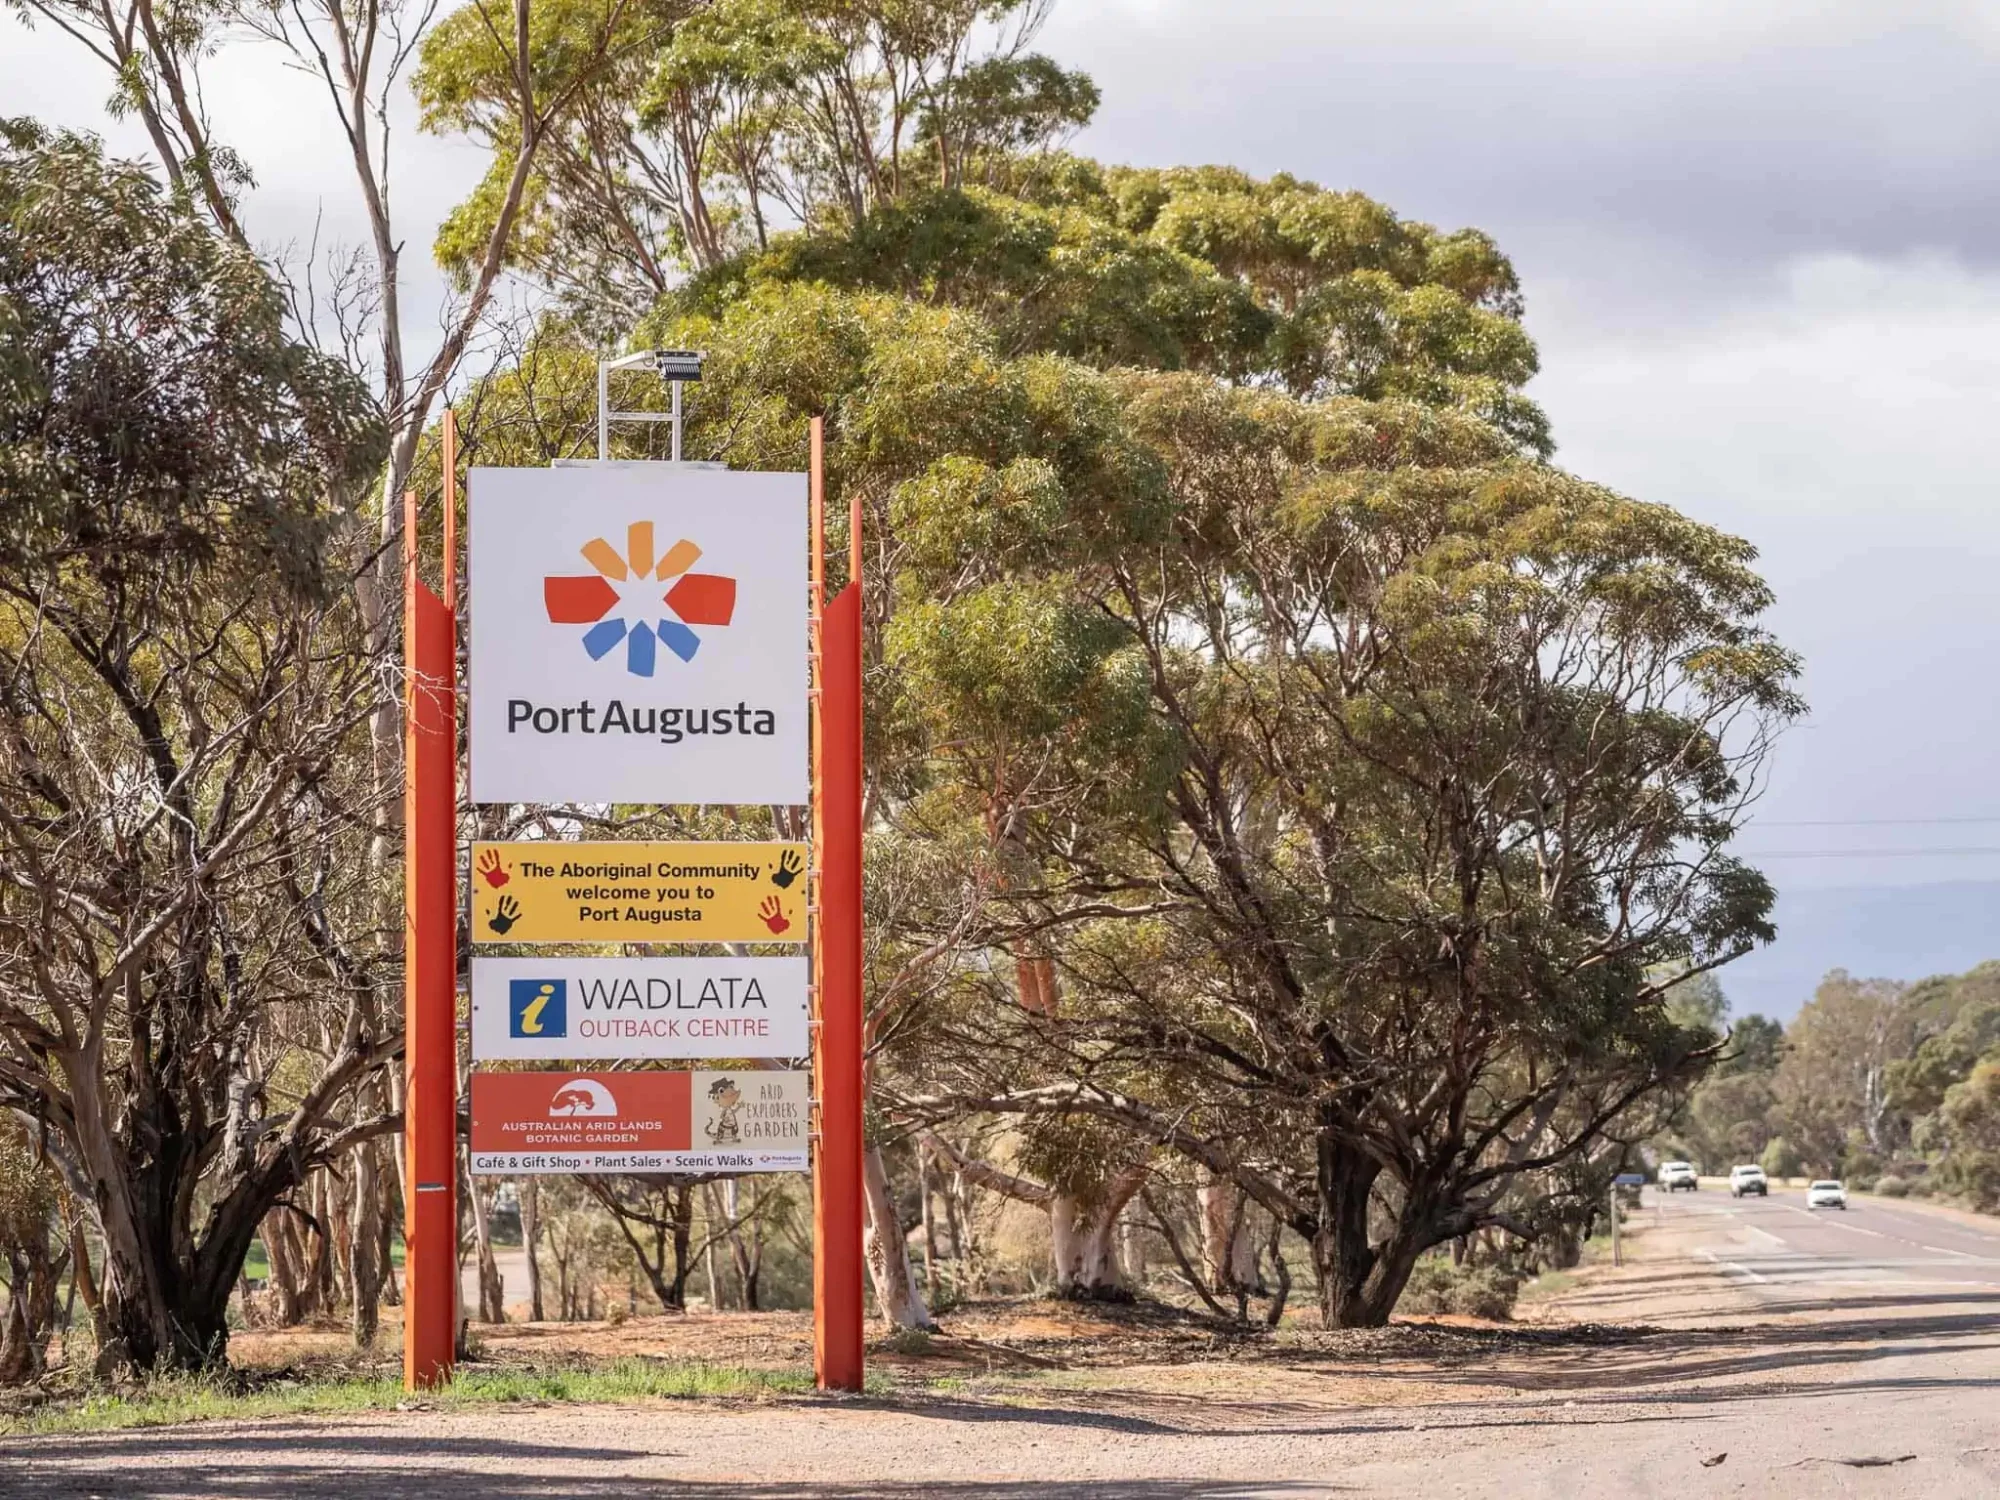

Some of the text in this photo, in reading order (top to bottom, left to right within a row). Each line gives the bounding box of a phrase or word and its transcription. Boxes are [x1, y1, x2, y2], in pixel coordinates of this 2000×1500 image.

[521, 863, 759, 880] The Aboriginal Community
[567, 885, 714, 902] welcome you to
[580, 907, 701, 924] Port Augusta
[579, 978, 767, 1009] WADLATA
[580, 1019, 768, 1037] OUTBACK CENTRE
[761, 1084, 783, 1100] ARID
[747, 1102, 797, 1118] EXPLORERS
[502, 1121, 661, 1132] AUSTRALIAN ARID LANDS
[745, 1121, 798, 1137] GARDEN
[527, 1134, 638, 1142] BOTANIC GARDEN
[477, 1155, 753, 1170] Café & Gift Shop Plant Sales Scenic Walks
